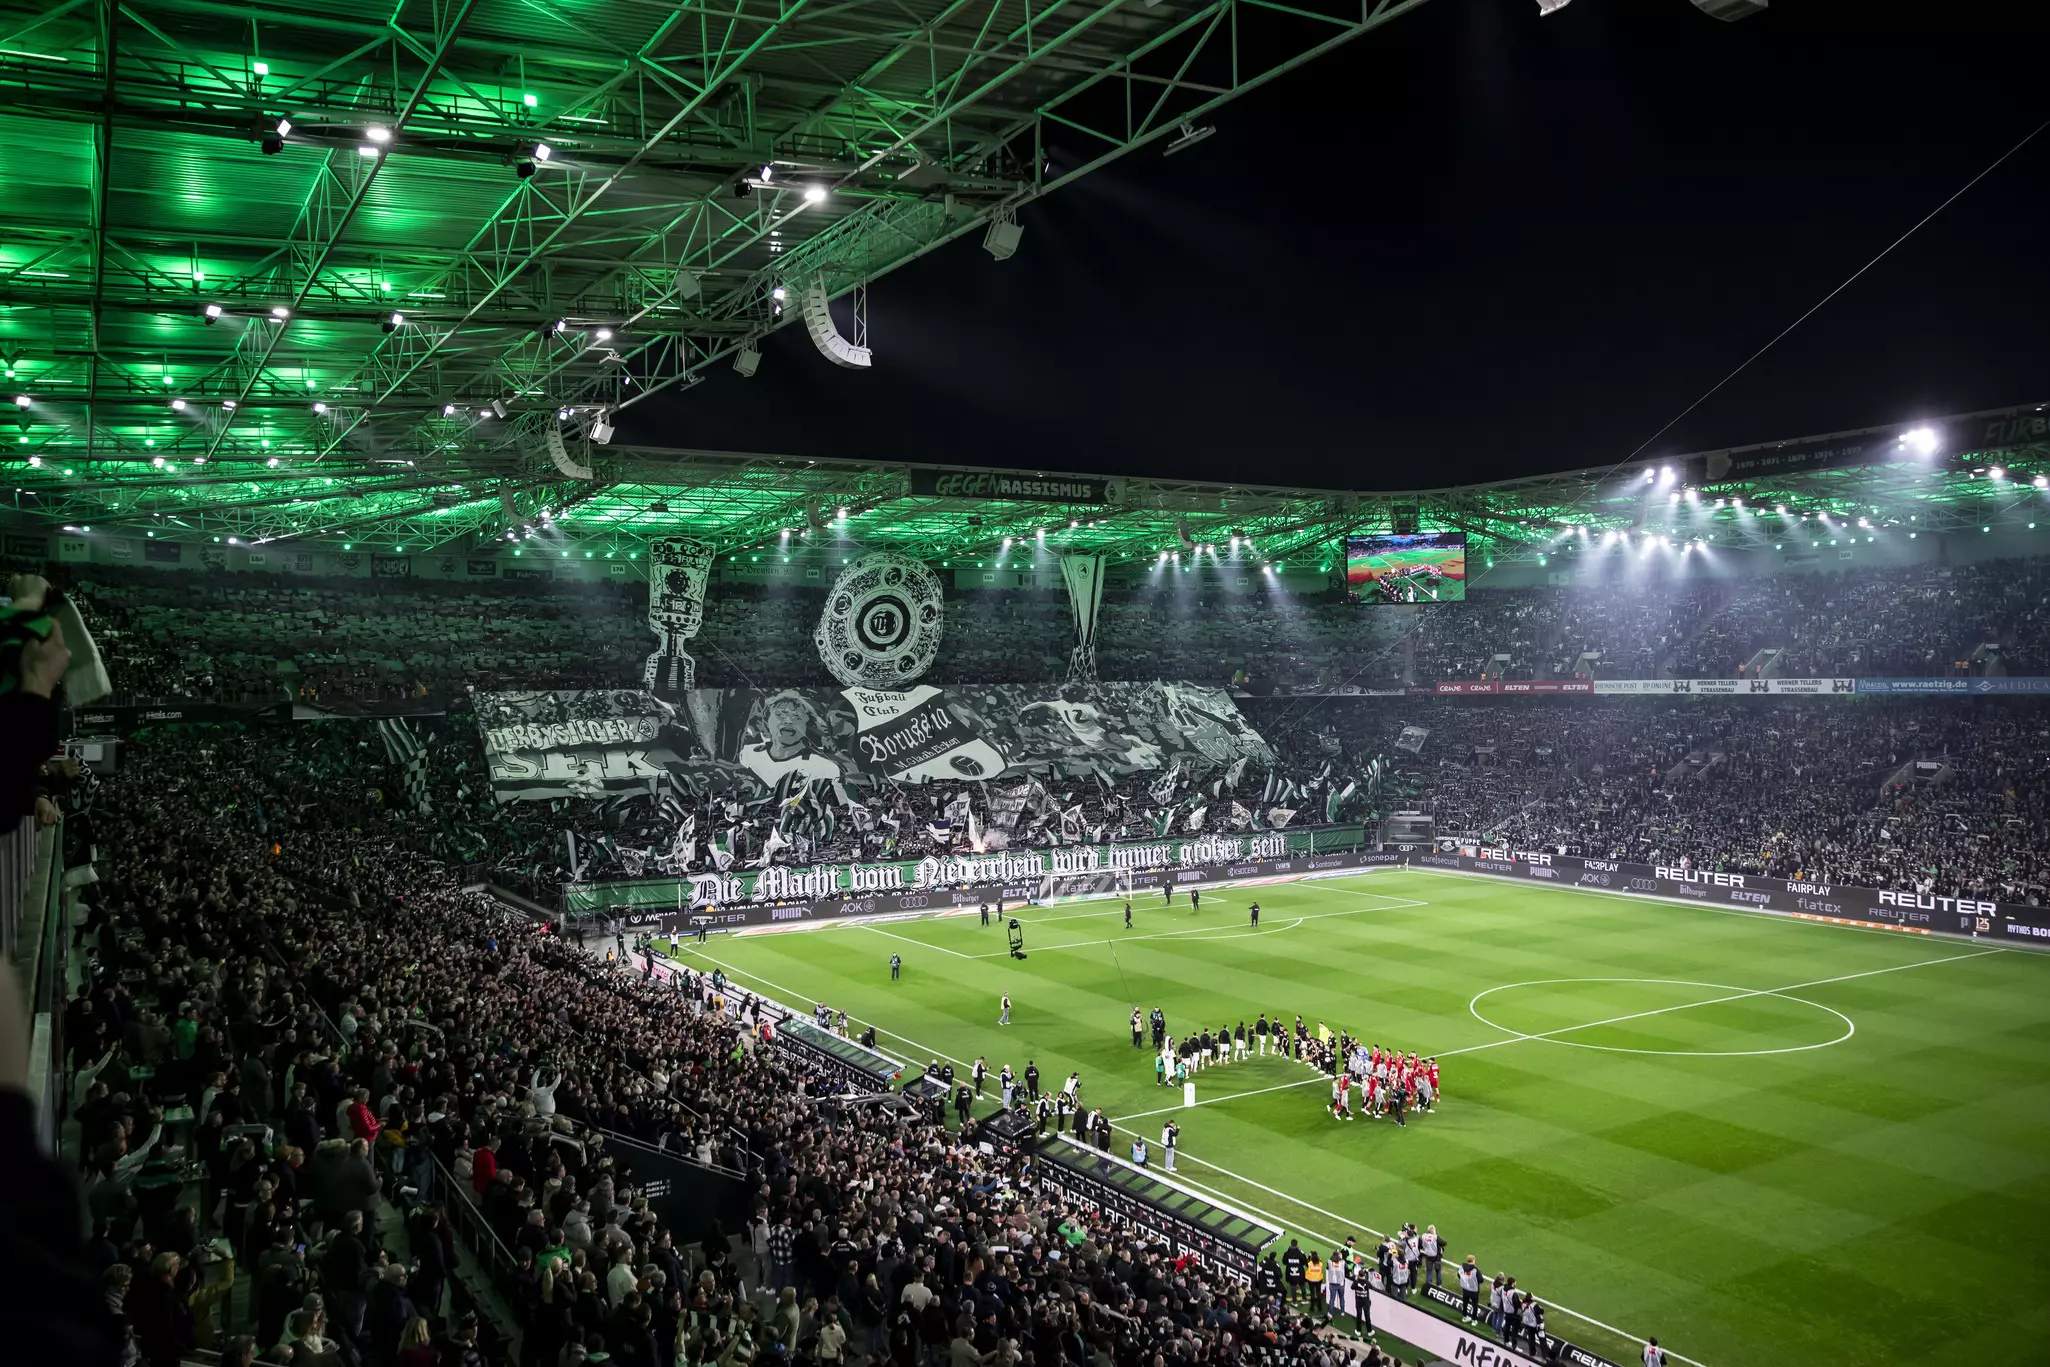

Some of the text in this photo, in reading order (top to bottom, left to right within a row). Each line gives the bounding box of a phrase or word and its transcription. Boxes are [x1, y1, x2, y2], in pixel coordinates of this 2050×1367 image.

[935, 474, 1092, 498] GEGEN RASSISMUS
[1891, 680, 1968, 688] www.raetzig.de
[487, 719, 636, 751] DERBYSIEGER
[1366, 854, 1399, 863] sonepar
[1480, 847, 1552, 866] REUTER
[687, 871, 745, 909] Die
[751, 864, 842, 902] Macht
[850, 863, 904, 892] vom
[911, 849, 1046, 892] Niederrhein
[1051, 844, 1100, 874] wird
[1108, 842, 1173, 869] immer
[1179, 834, 1245, 867] größer
[1250, 830, 1288, 857] sein
[1233, 866, 1258, 876] KYOCERA
[1315, 859, 1343, 869] Santander
[1474, 861, 1512, 872] REUTER
[1584, 859, 1619, 873] FAIRPLAY
[1177, 872, 1200, 882] PUMA
[1530, 866, 1552, 878] PUMA
[1580, 873, 1600, 884] AOK
[1655, 866, 1745, 888] REUTER
[1060, 882, 1096, 893] flatex
[1679, 884, 1707, 898] Bitburger
[1786, 881, 1831, 896] FAIRPLAY
[1730, 890, 1771, 904] ELTEN
[1878, 890, 1997, 918] REUTER
[840, 902, 863, 914] AOK
[1796, 897, 1841, 914] flatex
[771, 906, 802, 920] PUMA
[1868, 907, 1930, 923] REUTER
[2007, 924, 2031, 936] MYTHOS
[1102, 1185, 1119, 1196] REUTER
[1119, 1194, 1136, 1204] REUTER
[1137, 1202, 1155, 1212] REUTER
[1155, 1210, 1174, 1221] REUTER
[1174, 1219, 1193, 1231] REUTER
[1194, 1228, 1213, 1240] REUTER
[1214, 1237, 1234, 1250] REUTER
[1235, 1247, 1255, 1260] REUTER
